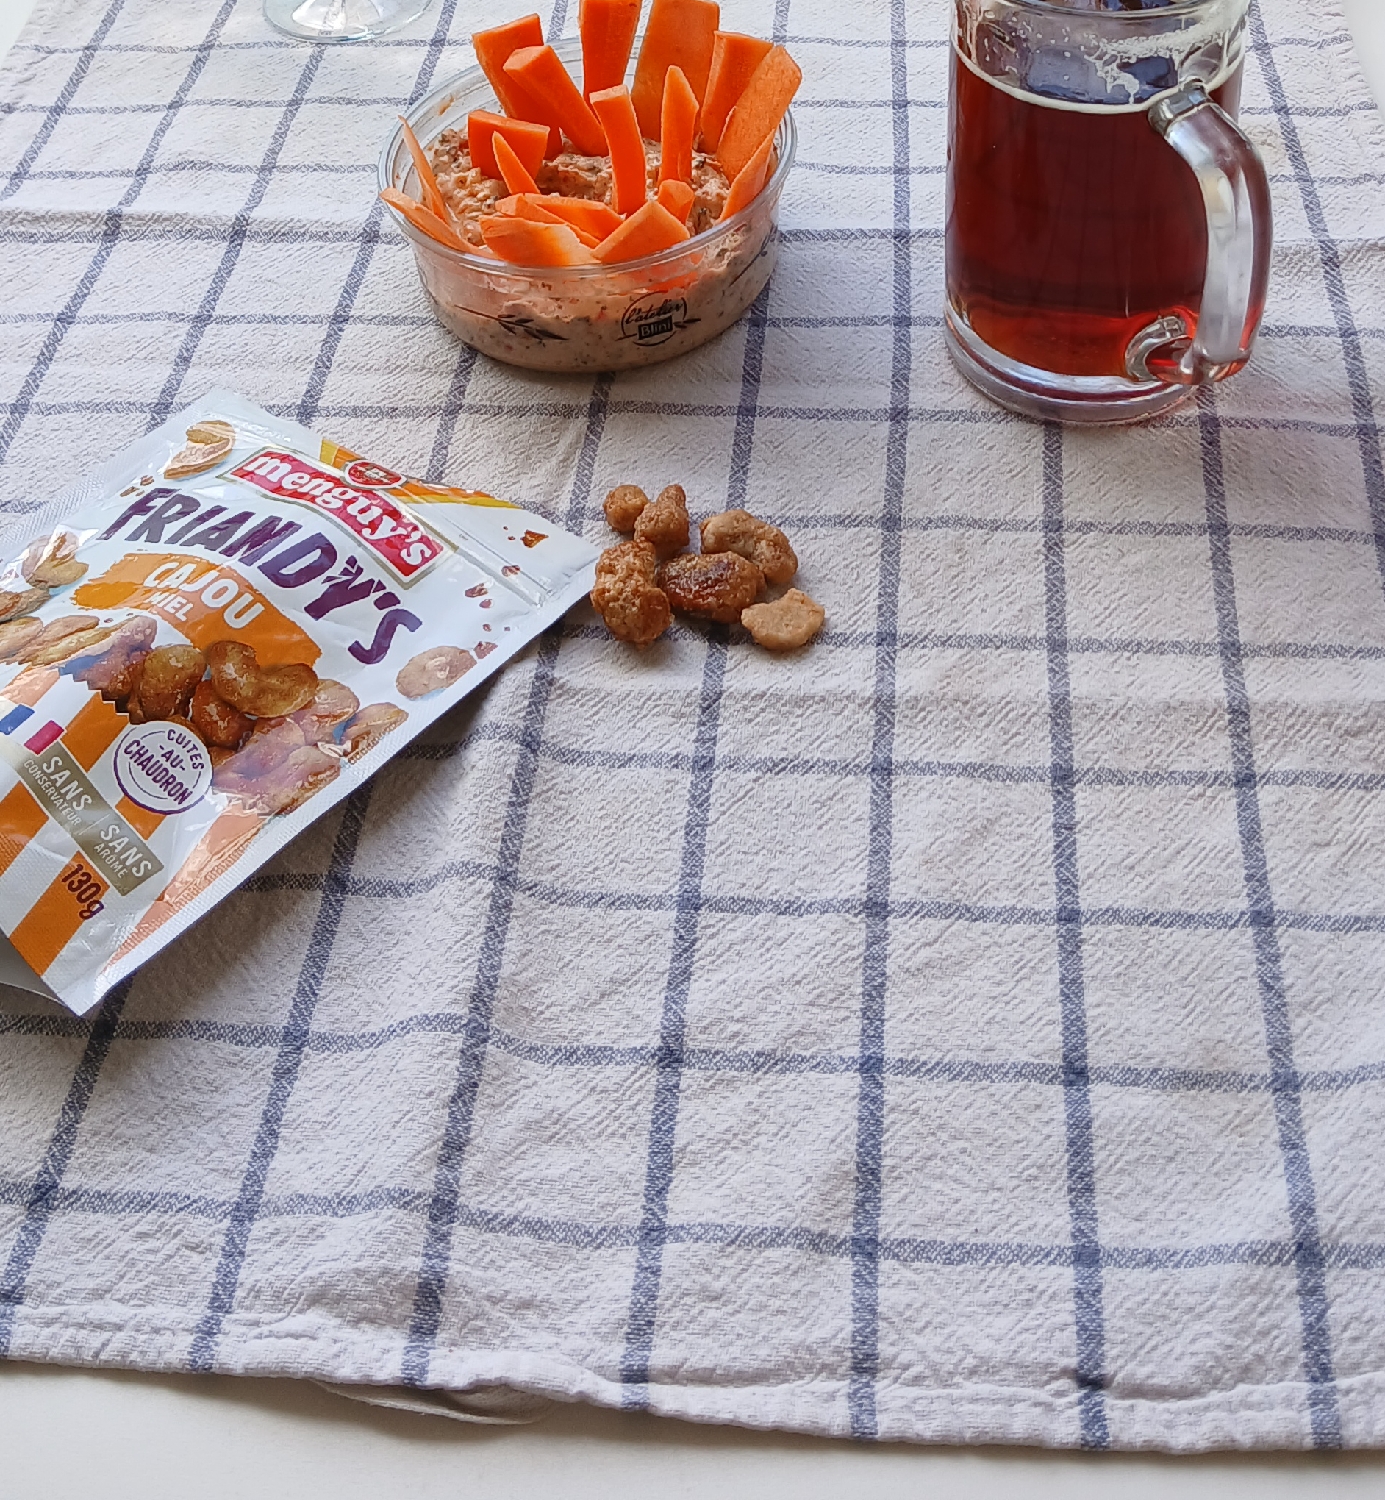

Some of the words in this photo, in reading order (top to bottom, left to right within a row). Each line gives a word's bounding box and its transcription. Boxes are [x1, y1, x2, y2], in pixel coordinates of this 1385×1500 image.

[245, 454, 433, 567] menguy's
[98, 487, 423, 665] FRIANDY'S
[143, 562, 265, 629] CAJOU
[146, 591, 193, 622] MIEL
[123, 739, 193, 805] CHAUDRON
[167, 729, 205, 771] CUITES
[24, 759, 82, 826] CONSERVATEUR
[43, 757, 92, 812] SANS
[100, 824, 151, 877] SANS
[61, 864, 104, 920] 130g
